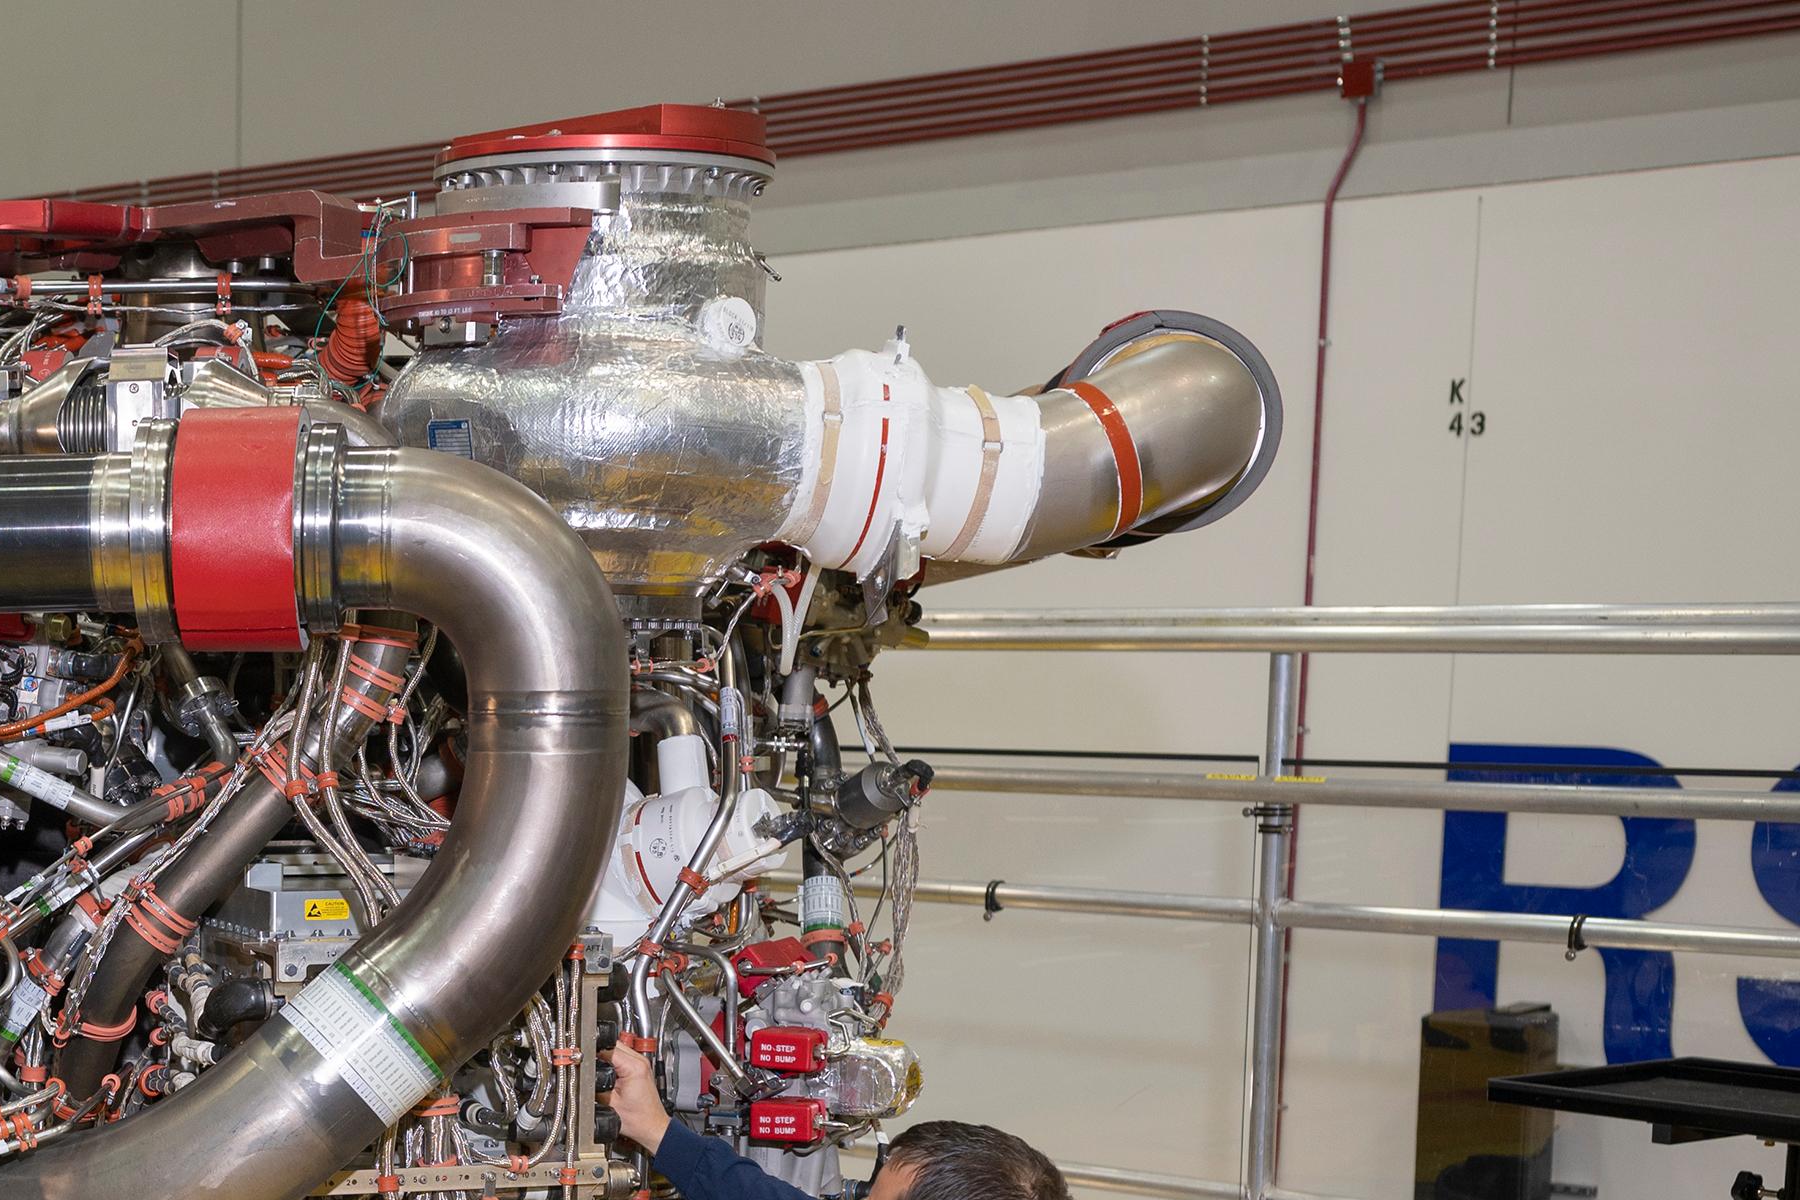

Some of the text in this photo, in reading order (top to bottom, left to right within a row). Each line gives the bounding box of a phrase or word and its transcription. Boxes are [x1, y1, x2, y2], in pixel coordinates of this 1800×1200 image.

[1450, 377, 1465, 404] K
[585, 944, 600, 952] AFT
[760, 1043, 796, 1053] NO STEP
[760, 1054, 796, 1064] NO BUMP
[759, 1116, 796, 1125] NO STEP
[759, 1126, 796, 1135] NO BUMP
